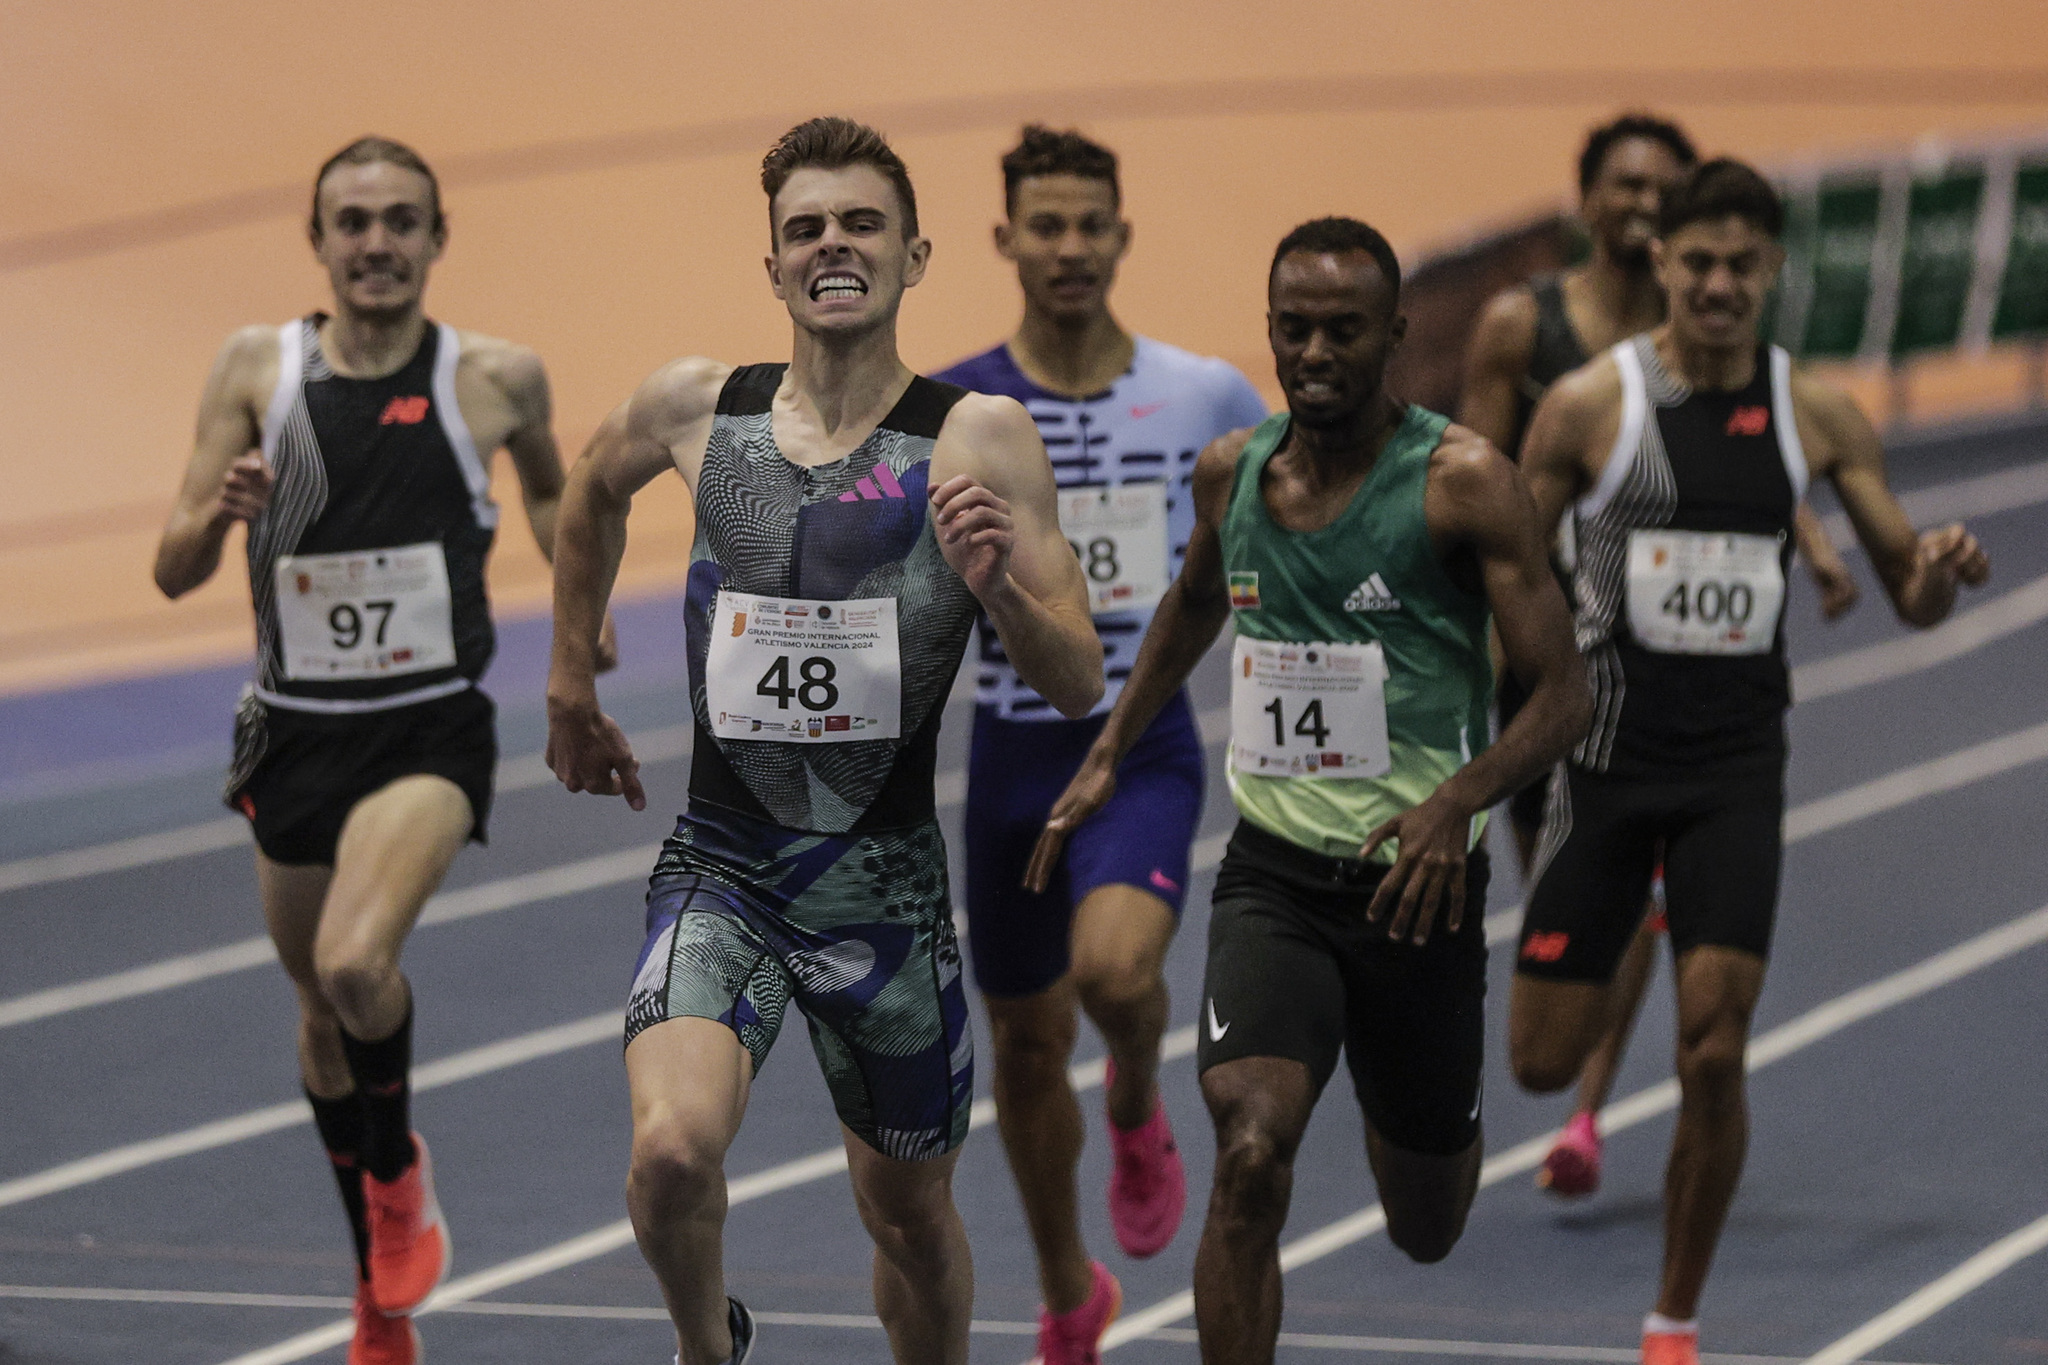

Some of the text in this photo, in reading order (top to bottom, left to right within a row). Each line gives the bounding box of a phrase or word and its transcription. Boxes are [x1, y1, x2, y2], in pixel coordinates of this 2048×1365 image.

[329, 601, 394, 649] 97
[1662, 580, 1752, 626] 400
[747, 628, 880, 640] GRAN PREMIO INTERNACIONAL
[755, 638, 802, 648] ATLETISMO
[757, 655, 839, 711] 48
[1265, 696, 1331, 747] 14
